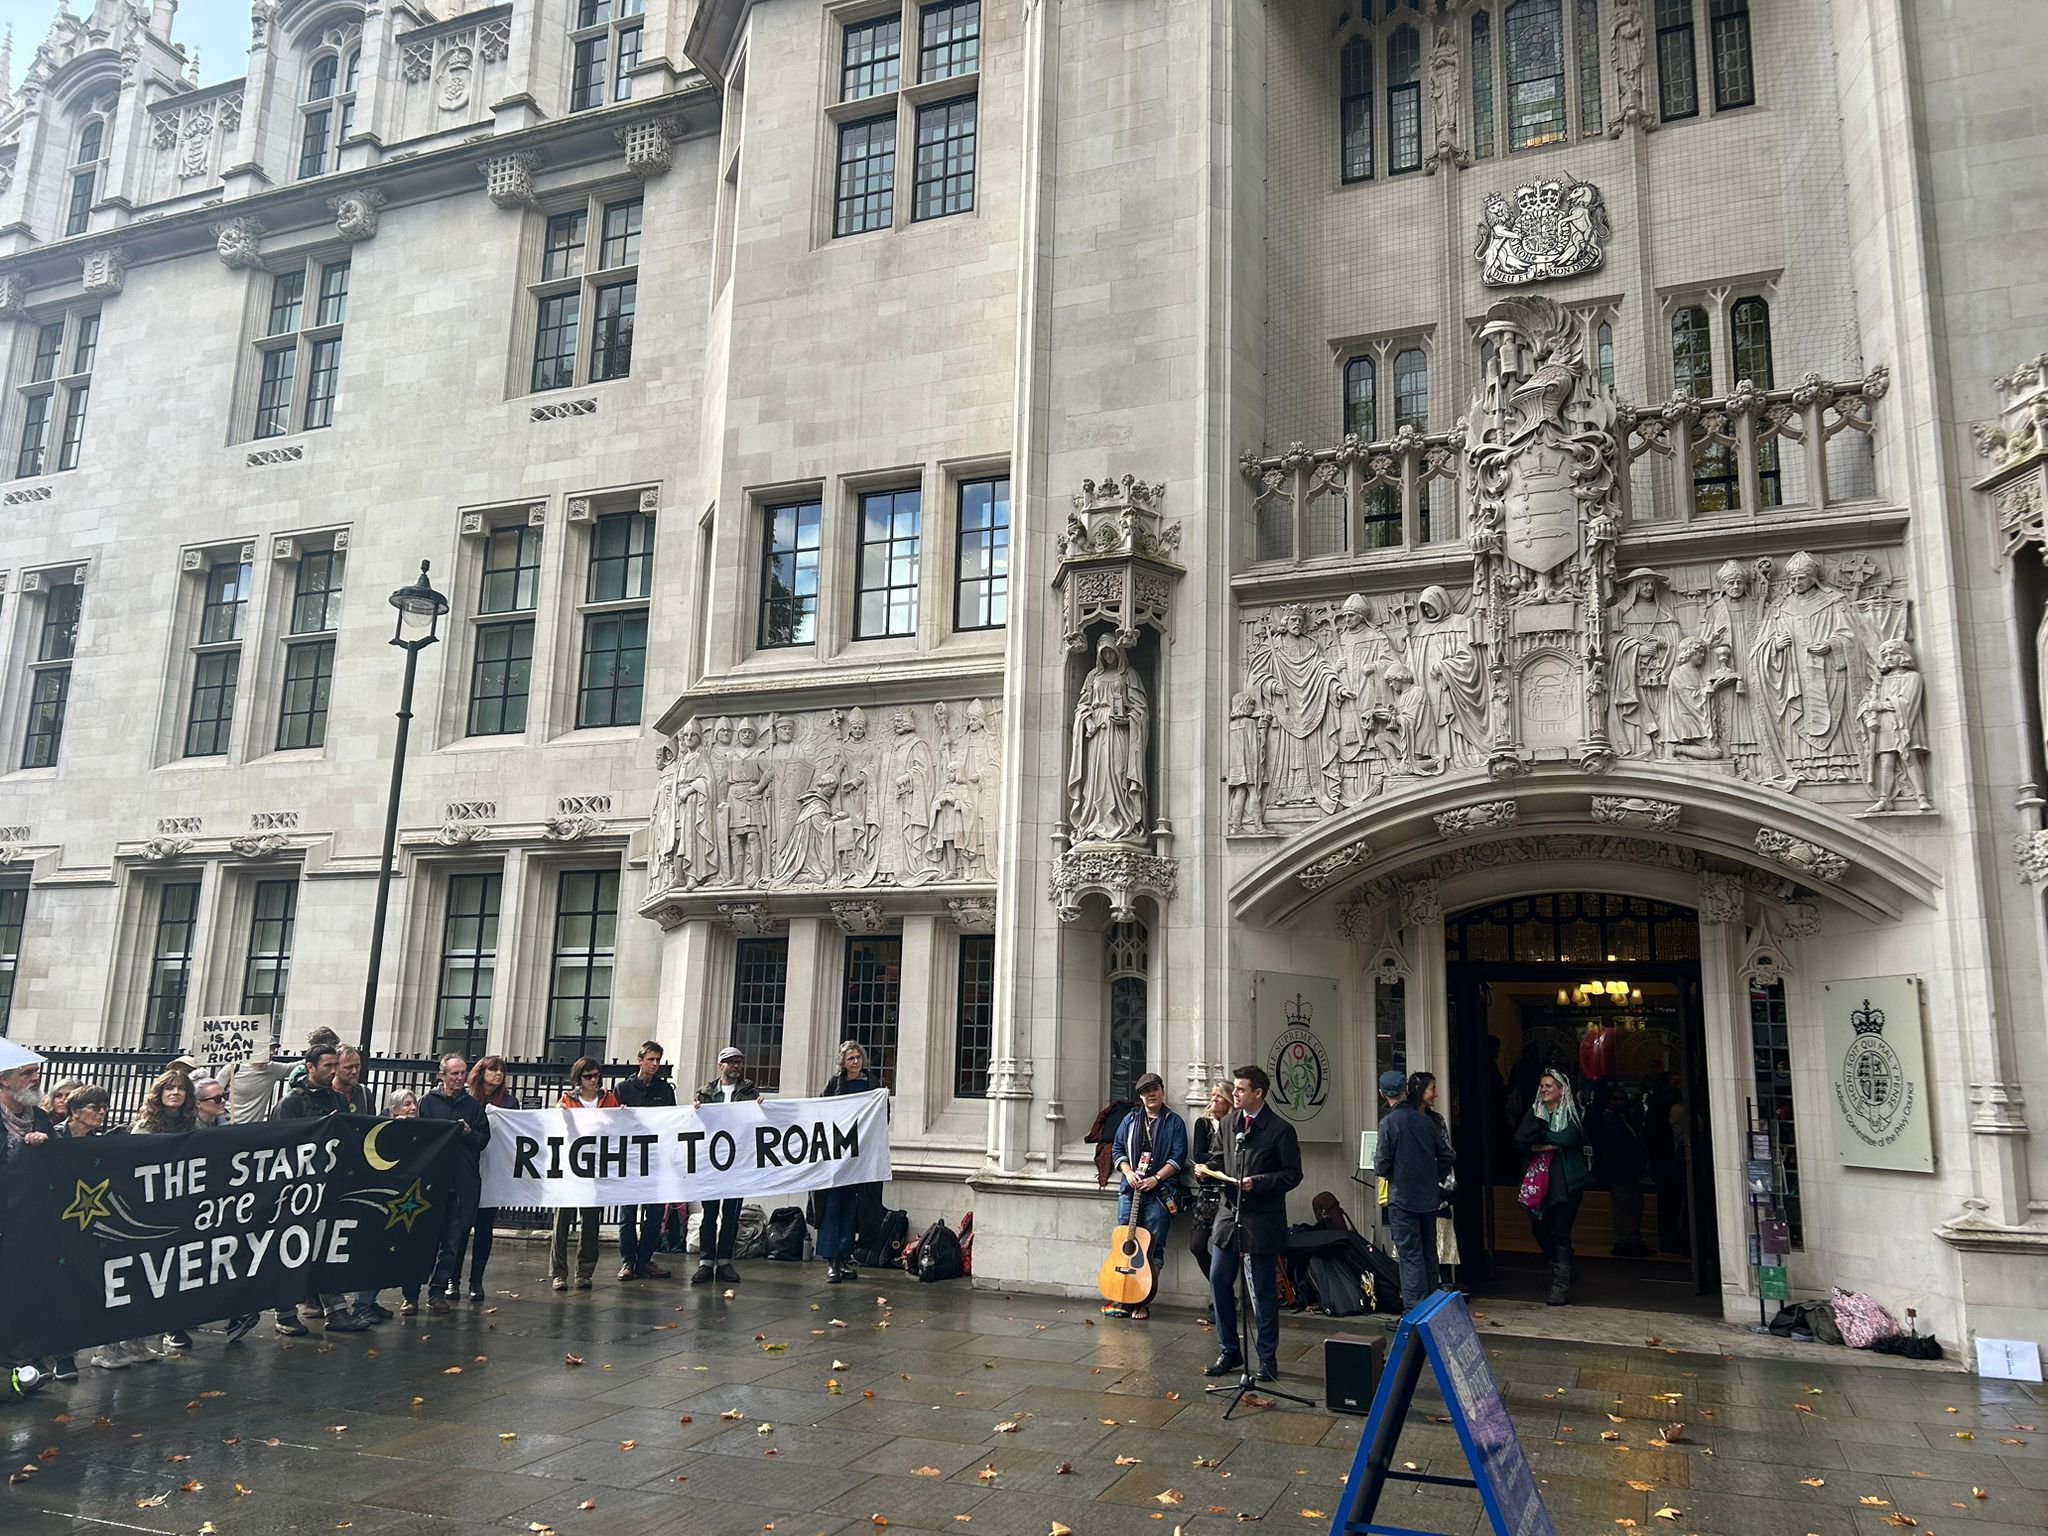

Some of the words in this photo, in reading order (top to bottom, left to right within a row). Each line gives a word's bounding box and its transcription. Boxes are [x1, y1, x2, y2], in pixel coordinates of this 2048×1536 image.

[1492, 269, 1515, 283] DIEU
[1518, 273, 1530, 282] ET
[1549, 267, 1571, 276] MON
[203, 1020, 259, 1032] NATURE
[201, 1039, 254, 1053] HUMAN
[211, 1034, 224, 1043] IS
[231, 1033, 242, 1042] A
[1860, 1040, 1876, 1049] QUI
[207, 1051, 253, 1063] RIGHT
[1269, 1055, 1278, 1078] THE
[1275, 1031, 1312, 1051] SUPREME
[1313, 1042, 1329, 1081] COURT
[1847, 1045, 1860, 1068] SOIT
[1877, 1042, 1894, 1062] MAL
[1891, 1063, 1898, 1071] Y
[1846, 1071, 1858, 1102] HONI
[1887, 1075, 1901, 1109] PENSE
[1834, 1081, 1848, 1114] Judicial
[1846, 1113, 1877, 1147] Committee
[1877, 1138, 1886, 1147] of
[1885, 1133, 1897, 1145] the
[1895, 1116, 1909, 1136] Privy
[1903, 1081, 1915, 1116] Council
[512, 1134, 659, 1179] RIGHT
[677, 1130, 736, 1174] TO
[755, 1117, 860, 1168] ROAM
[134, 1157, 207, 1203] THE
[228, 1138, 340, 1187] STARS
[194, 1192, 256, 1230] are
[267, 1181, 327, 1224] for
